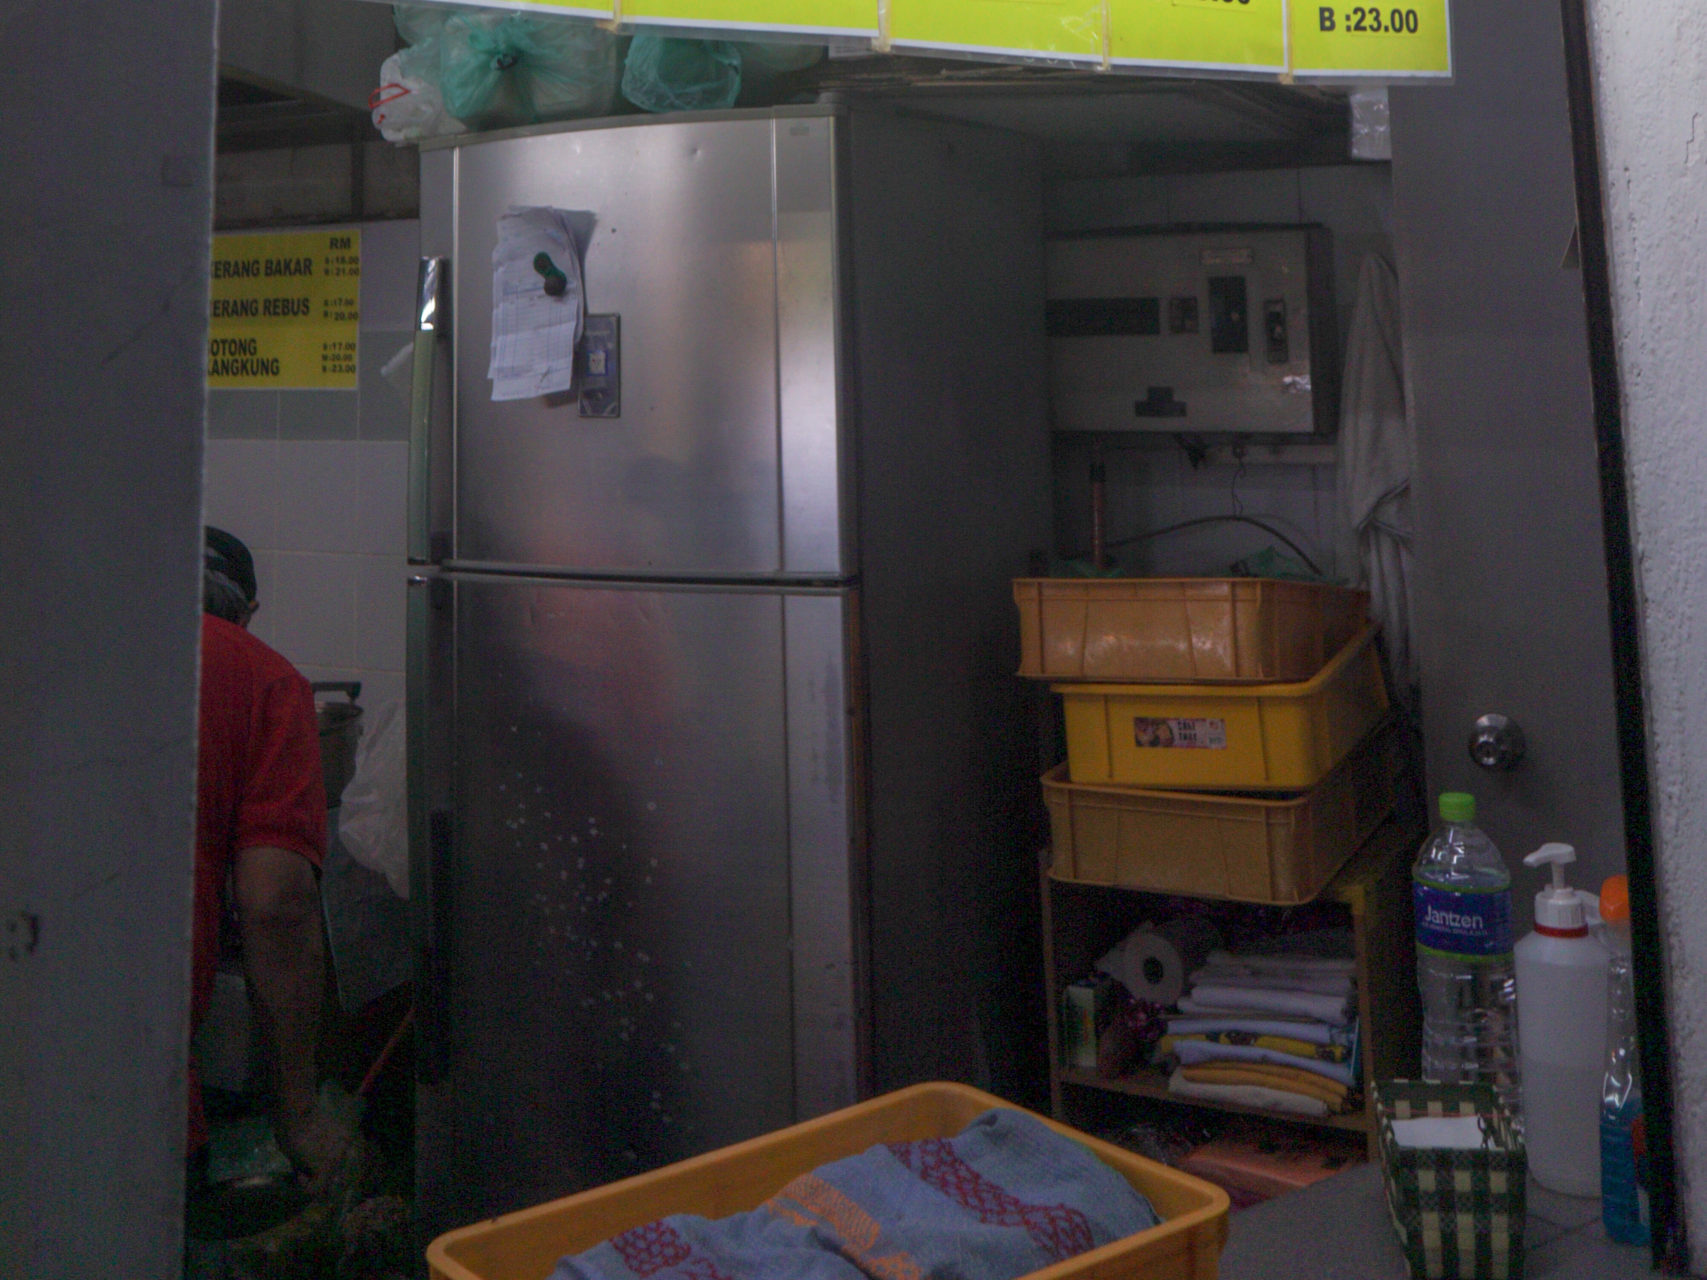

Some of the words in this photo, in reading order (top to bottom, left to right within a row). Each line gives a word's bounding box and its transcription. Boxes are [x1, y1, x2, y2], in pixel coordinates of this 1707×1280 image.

[329, 237, 351, 250] RM
[211, 260, 260, 279] ERANG
[264, 258, 312, 277] BAKAR
[211, 299, 258, 317] ERANG
[263, 298, 310, 317] REBUS
[208, 338, 257, 357] OTONG
[208, 358, 280, 377] ANGKUNG
[1425, 904, 1483, 930] Jantzen
